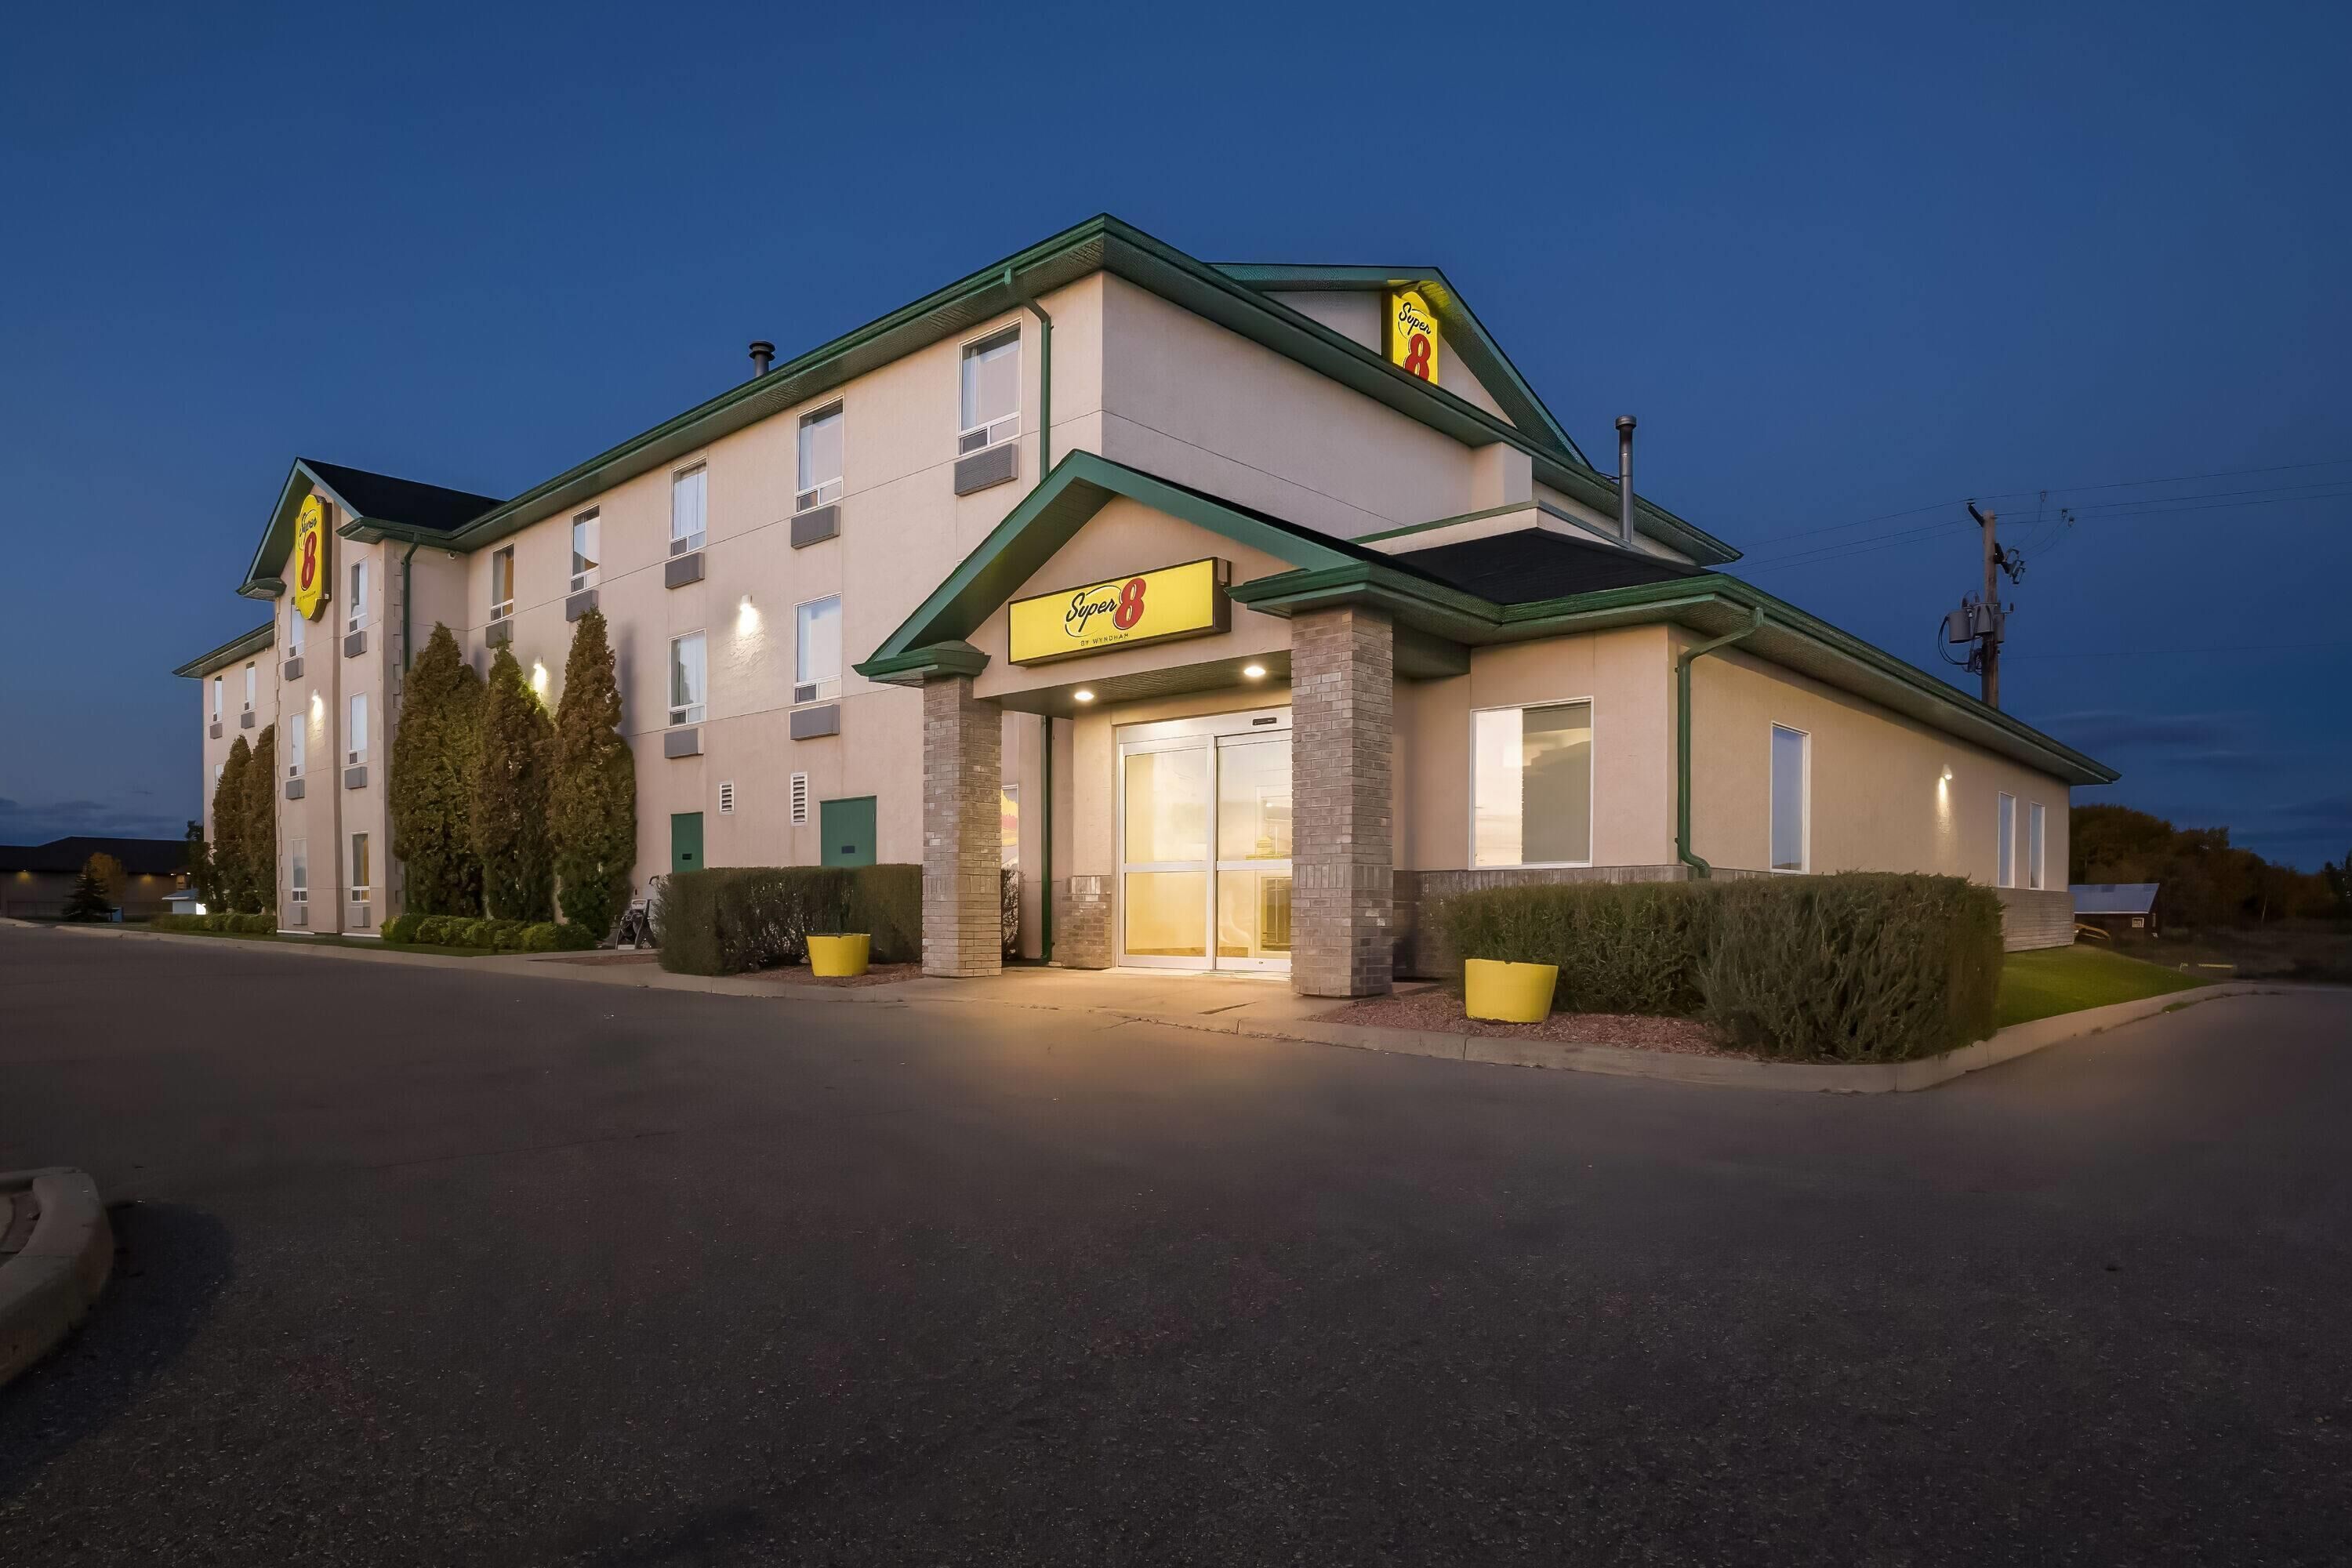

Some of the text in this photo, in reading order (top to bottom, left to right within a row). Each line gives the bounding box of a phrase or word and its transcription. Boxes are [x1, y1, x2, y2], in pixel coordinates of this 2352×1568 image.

[1398, 301, 1432, 336] Super
[1403, 333, 1432, 382] 8
[300, 531, 318, 591] 8
[1065, 577, 1147, 633] Super 8
[1092, 632, 1130, 644] WYNDHAM
